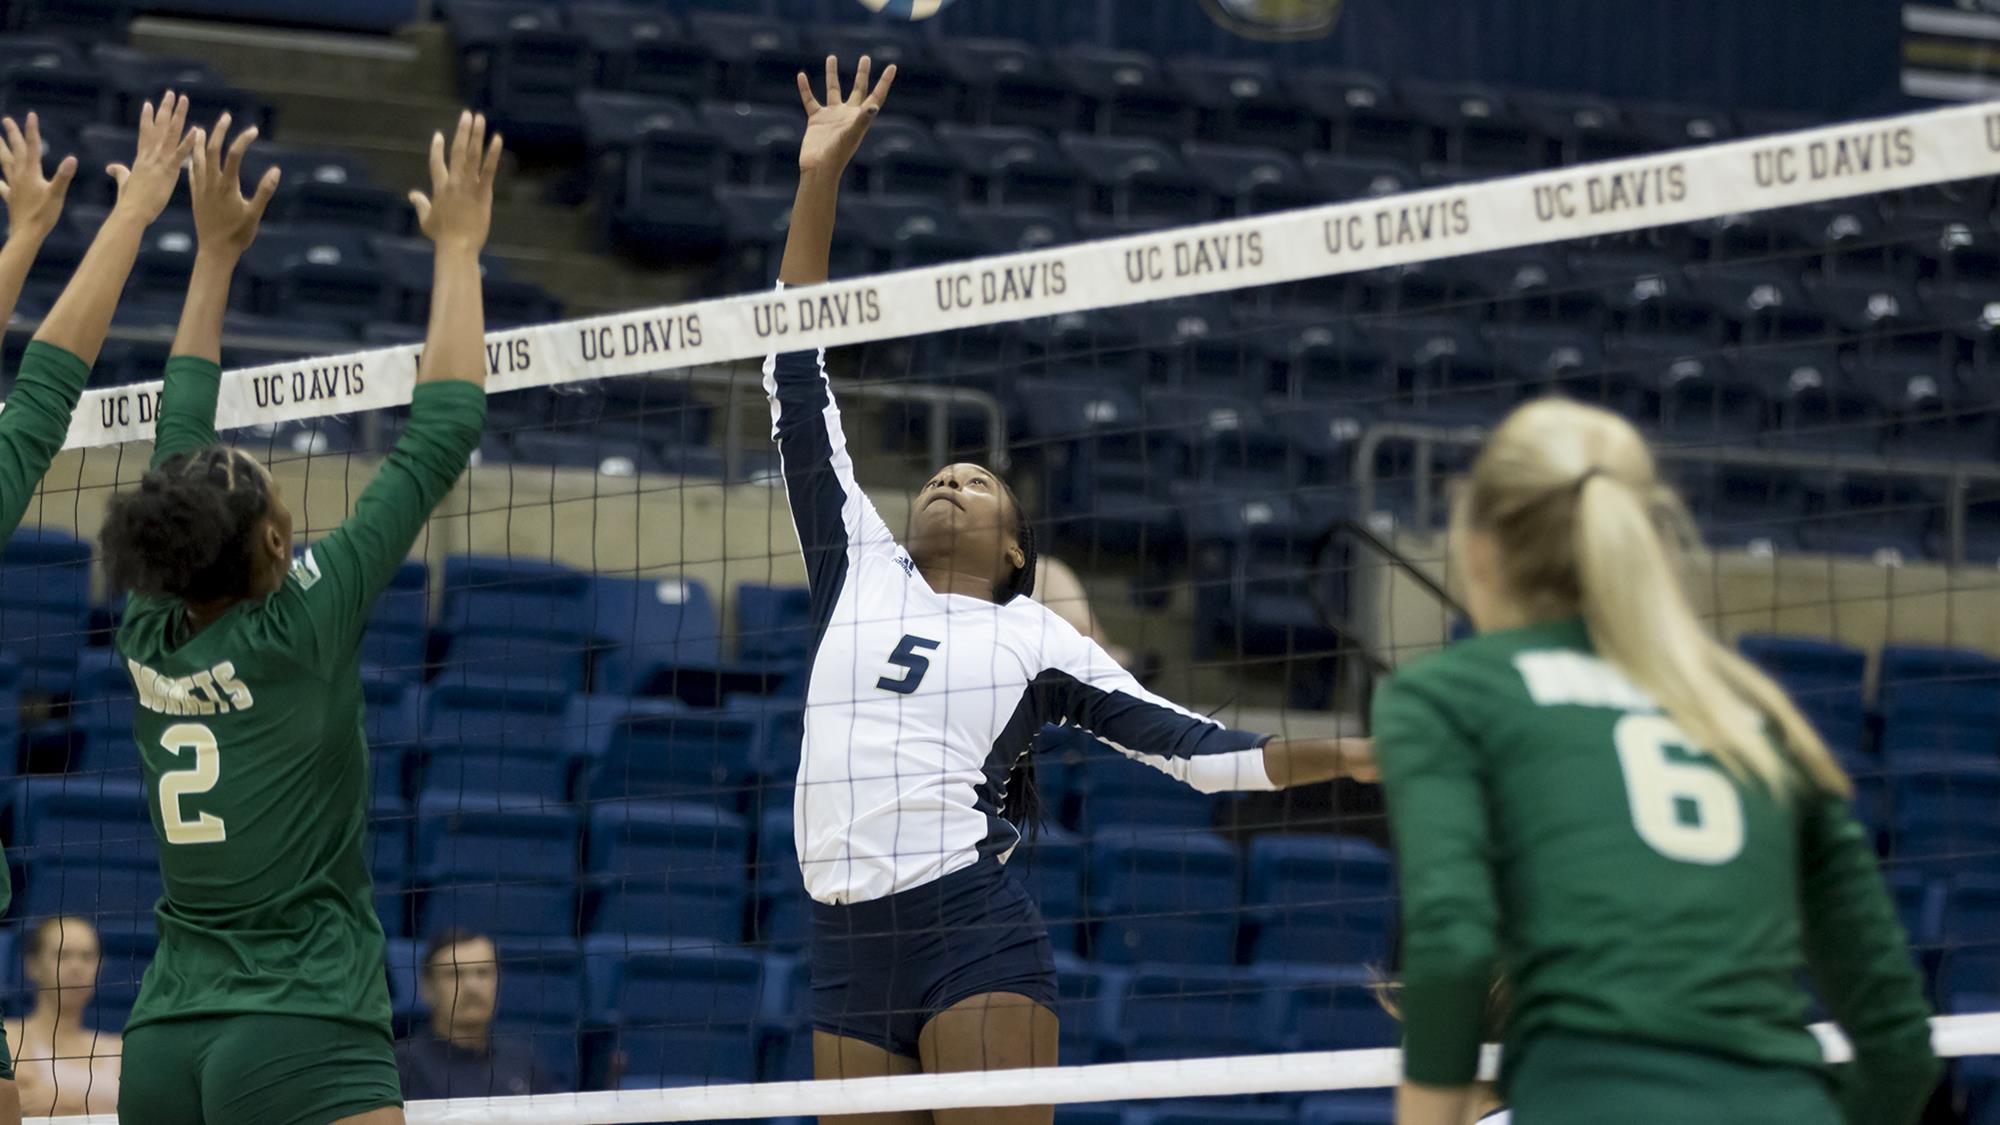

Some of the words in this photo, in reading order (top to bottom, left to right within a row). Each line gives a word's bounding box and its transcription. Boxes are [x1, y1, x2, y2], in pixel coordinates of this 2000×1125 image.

[1753, 146, 1798, 188] UC
[1809, 128, 1915, 181] DAVIS
[1984, 112, 2000, 152] U
[1533, 181, 1575, 222] UC
[1588, 165, 1688, 214] DAVIS
[1324, 215, 1364, 254] UC
[1376, 199, 1471, 247] DAVIS
[1126, 247, 1164, 284] UC
[1173, 231, 1264, 276] DAVIS
[936, 276, 973, 312] UC
[981, 261, 1067, 304] DAVIS
[580, 327, 615, 361] UC
[623, 314, 702, 356] DAVIS
[754, 302, 789, 337] UC
[799, 289, 881, 331] DAVIS
[484, 339, 531, 375] VIS
[253, 375, 284, 407] UC
[292, 363, 365, 402] DAVIS
[101, 396, 129, 428] UC
[875, 633, 941, 695] 5
[159, 723, 226, 844] 2
[1613, 713, 1746, 865] 6
